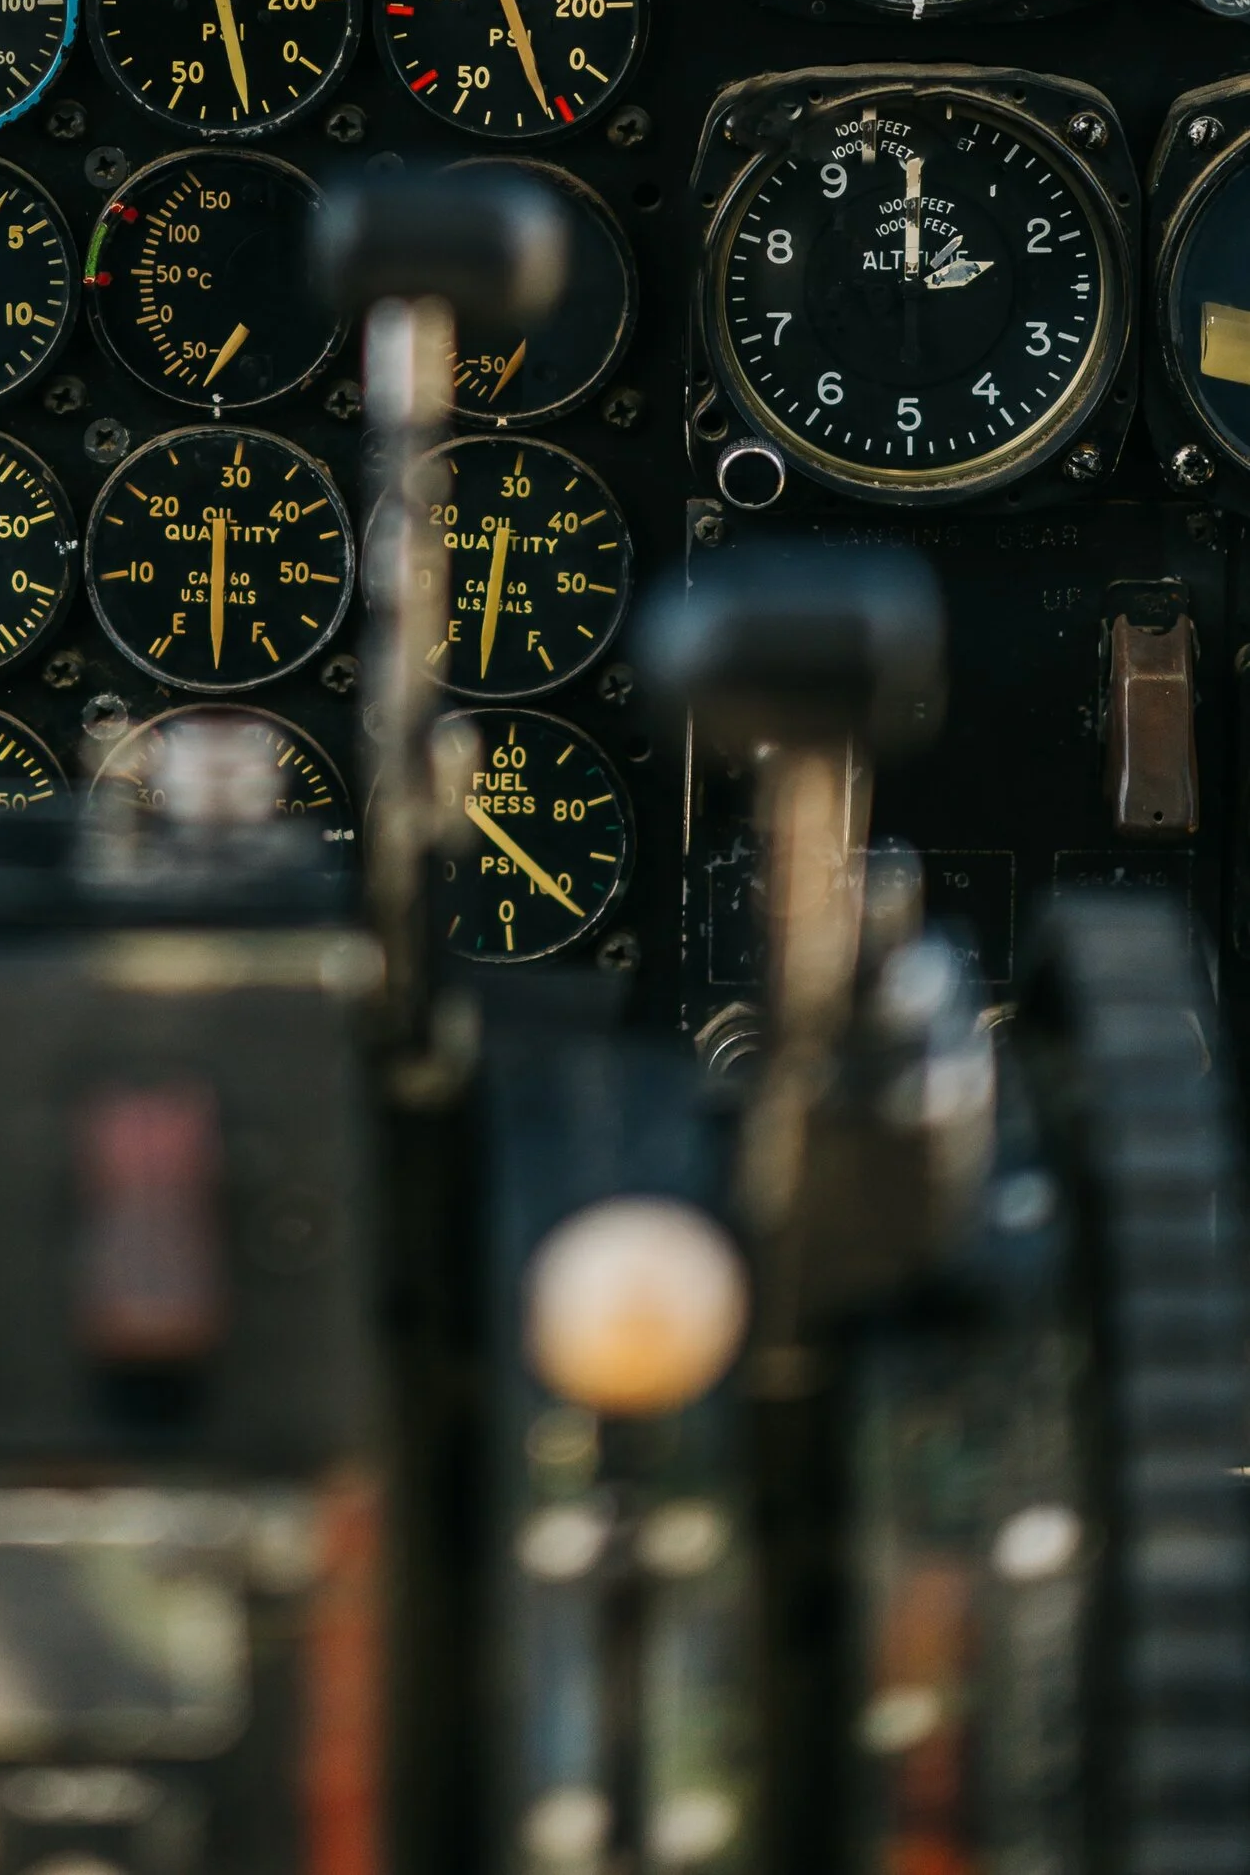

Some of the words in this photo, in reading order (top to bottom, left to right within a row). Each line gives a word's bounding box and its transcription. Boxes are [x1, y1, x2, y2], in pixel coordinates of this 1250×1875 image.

[877, 120, 911, 137] FEET
[880, 140, 914, 160] FEET
[820, 163, 847, 198] 9
[200, 191, 231, 210] 150
[921, 197, 955, 214] FEET
[924, 218, 958, 237] FEET
[1027, 218, 1051, 253] 2
[767, 229, 793, 264] 8
[156, 266, 181, 283] 50
[767, 312, 792, 345] 7
[1026, 322, 1050, 356] 3
[818, 371, 843, 405] 6
[972, 372, 1000, 405] 4
[897, 397, 921, 432] 5
[221, 466, 251, 488] 30
[501, 476, 530, 498] 30
[149, 496, 179, 517] 20
[202, 507, 238, 524] OIL
[269, 501, 300, 523] 40
[165, 525, 281, 543] QUATITY
[444, 533, 558, 554] QUATITY
[279, 562, 309, 584] 50
[557, 573, 586, 594] 50
[181, 589, 208, 602] U.S.
[457, 597, 485, 611] U.S.
[172, 612, 186, 634] E
[253, 622, 265, 643] F
[492, 746, 526, 769] 60
[473, 773, 528, 791] FUEL
[465, 795, 536, 814] PRESS
[553, 799, 585, 821] 80
